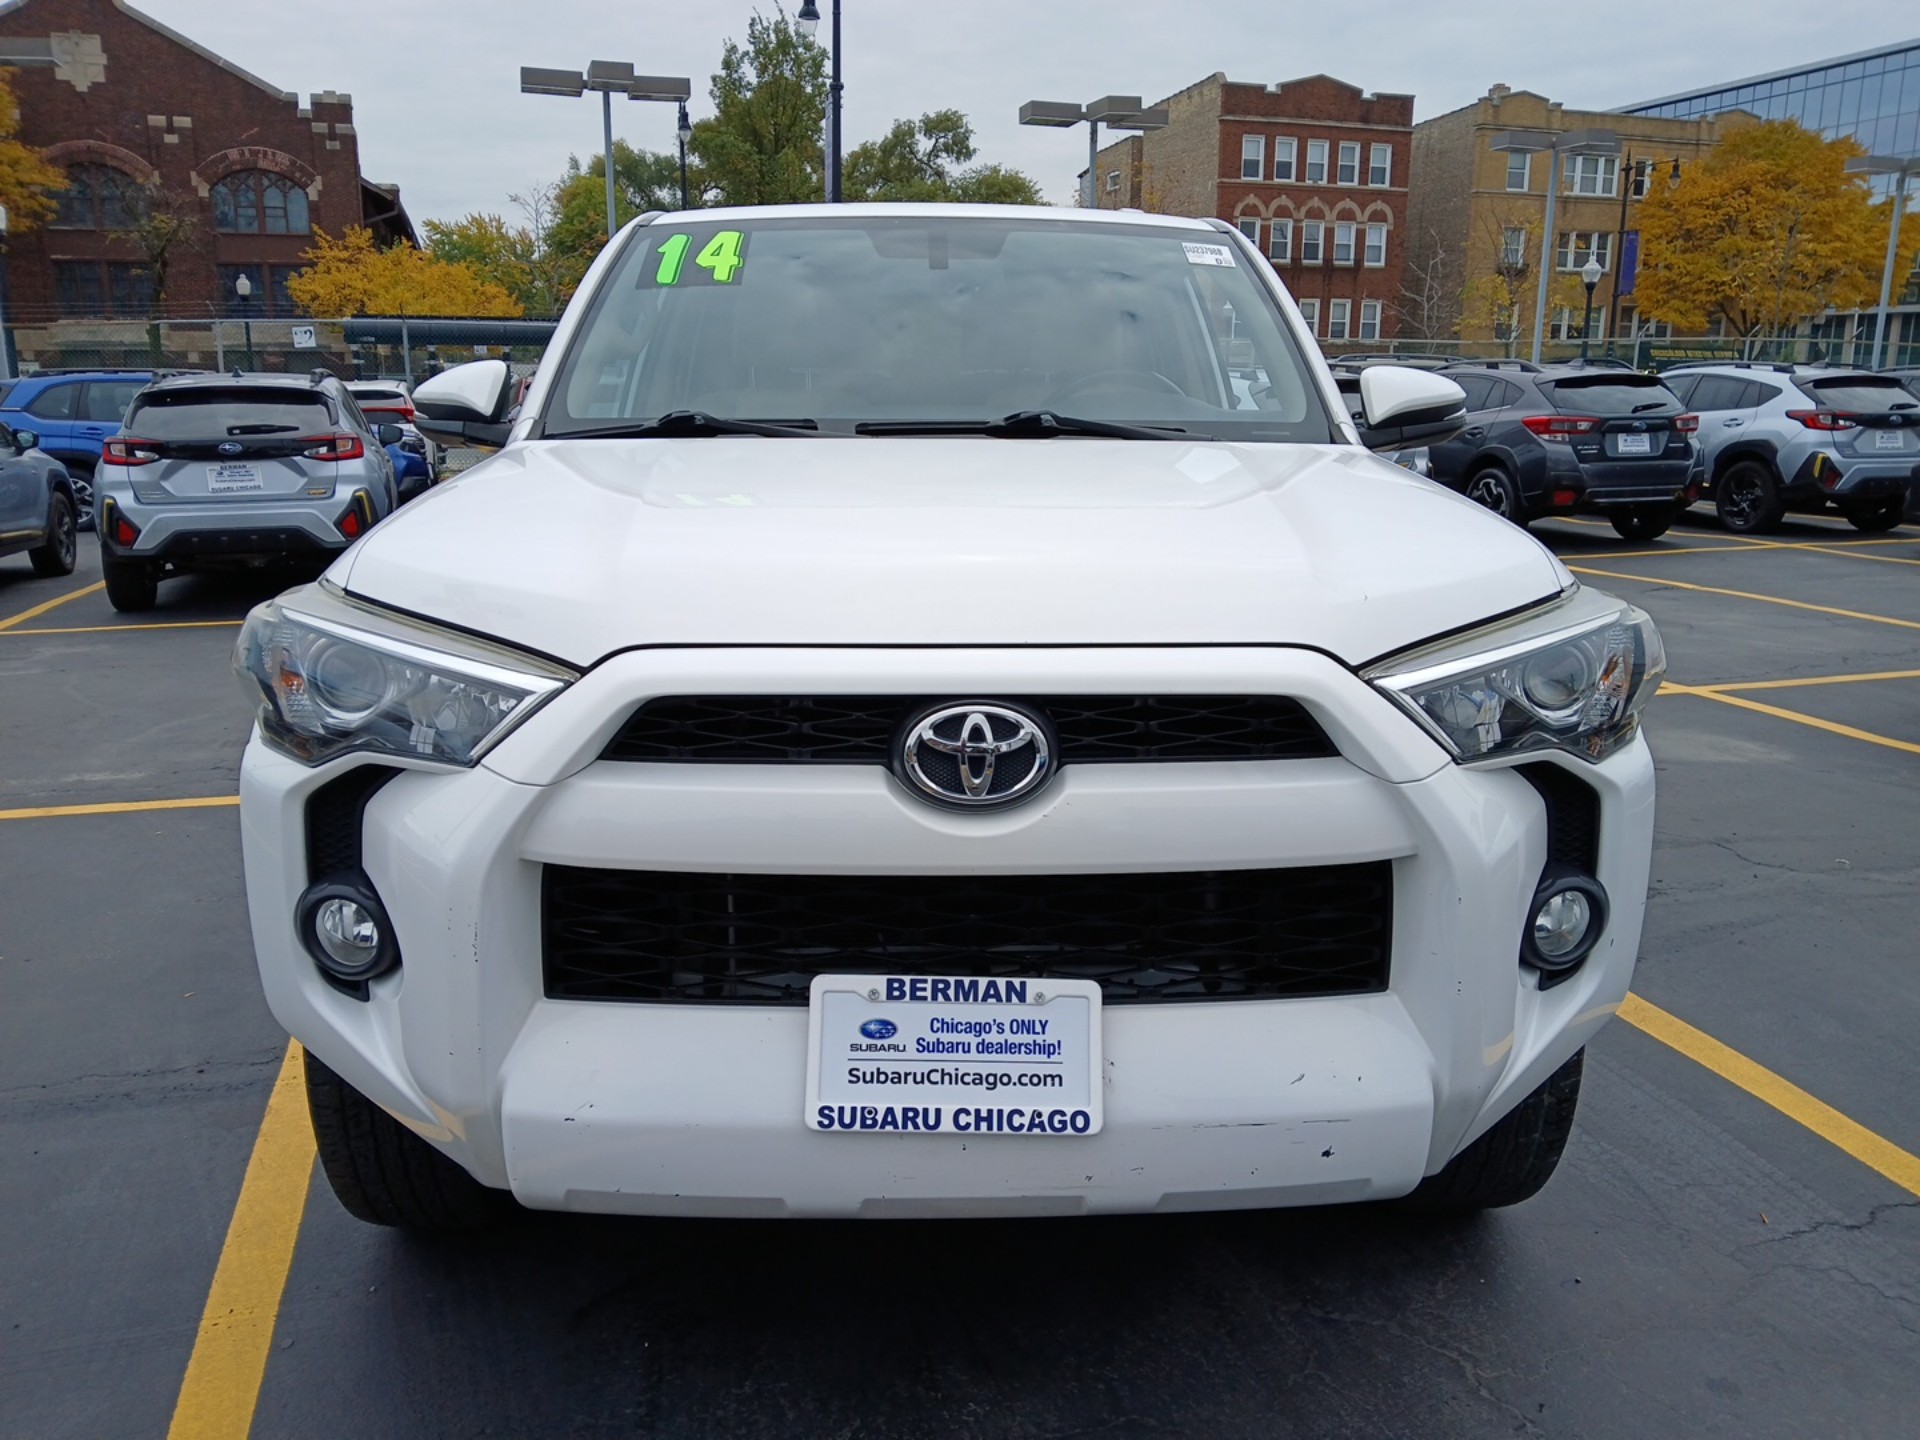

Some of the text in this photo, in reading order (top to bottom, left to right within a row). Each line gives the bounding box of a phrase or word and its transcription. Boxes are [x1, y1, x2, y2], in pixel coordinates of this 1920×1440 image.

[656, 231, 744, 285] 14
[885, 978, 1028, 1003] BERMAN
[929, 1017, 1049, 1036] Chicago's ONLY
[849, 1043, 906, 1053] SUBARU
[915, 1037, 1062, 1060] Subaru dealership!
[847, 1067, 1064, 1091] SubaruChicago.com
[816, 1105, 1092, 1133] SUBARU CHICAGO
